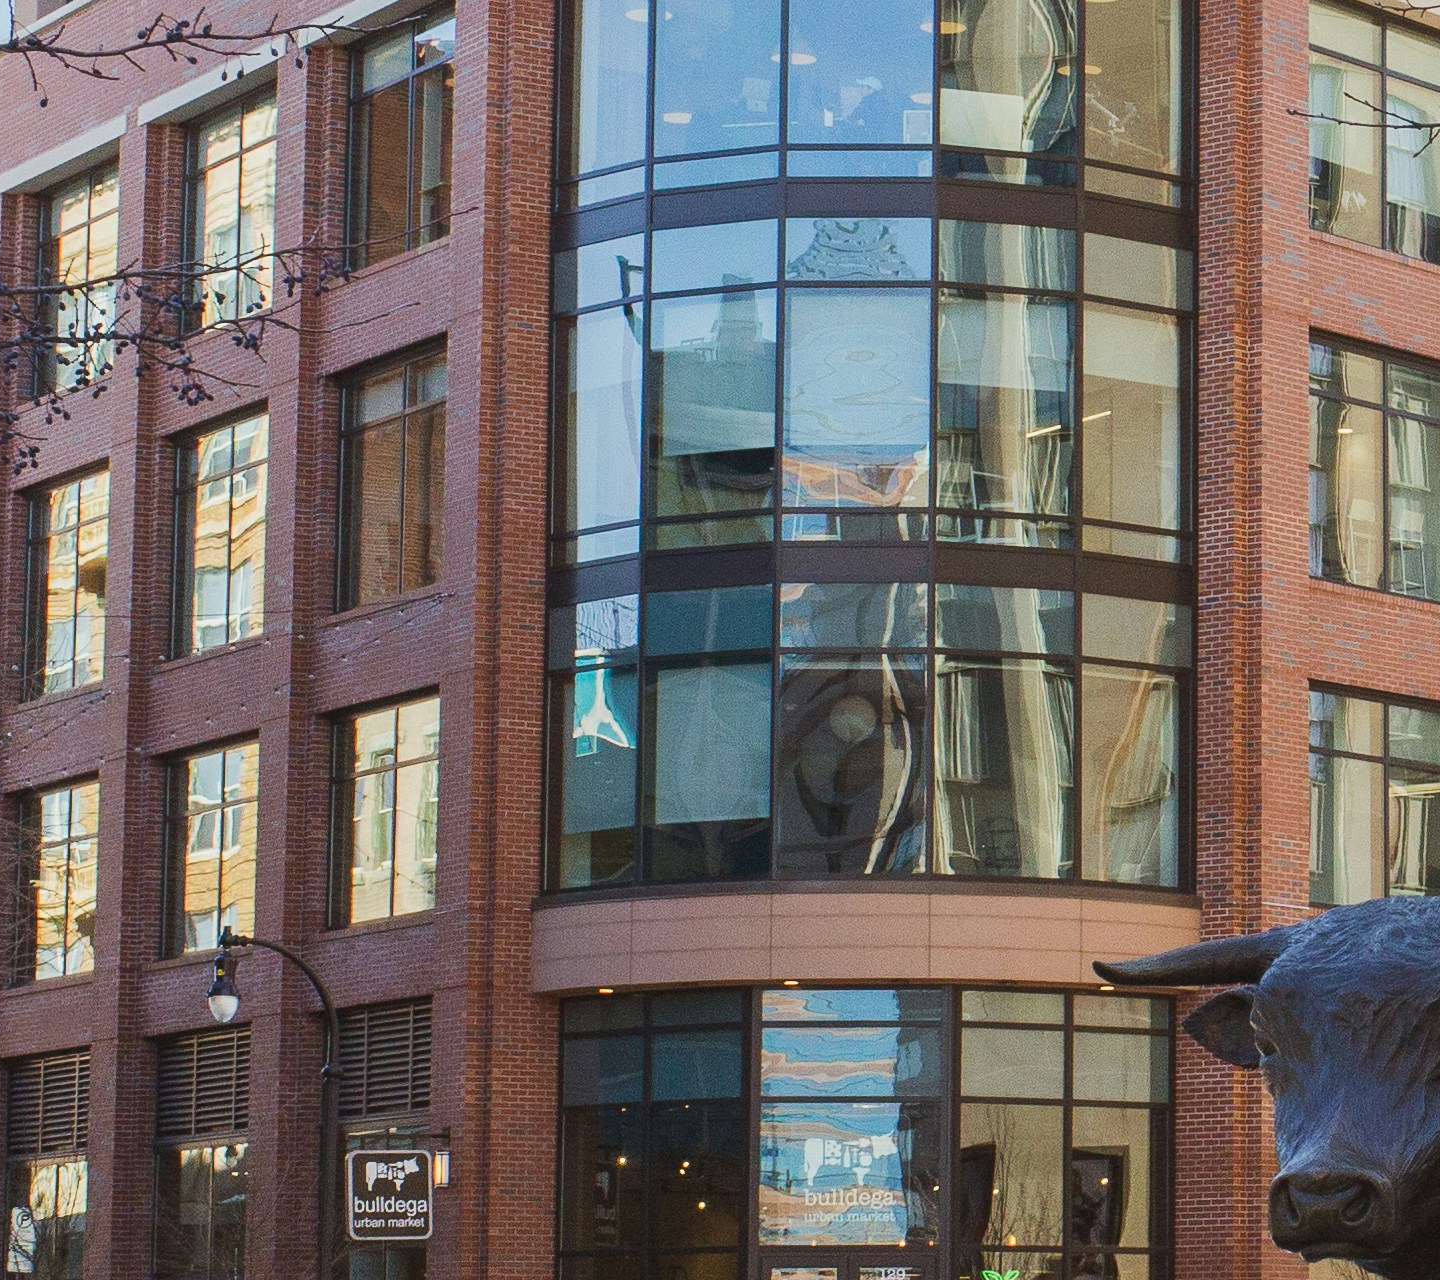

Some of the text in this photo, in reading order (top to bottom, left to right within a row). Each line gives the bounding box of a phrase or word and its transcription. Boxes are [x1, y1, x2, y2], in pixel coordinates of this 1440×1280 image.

[803, 1188, 897, 1209] bulldega
[354, 1196, 428, 1216] bulldega
[354, 1217, 425, 1228] urban market
[804, 1211, 896, 1222] urban market
[881, 1268, 906, 1280] 129
